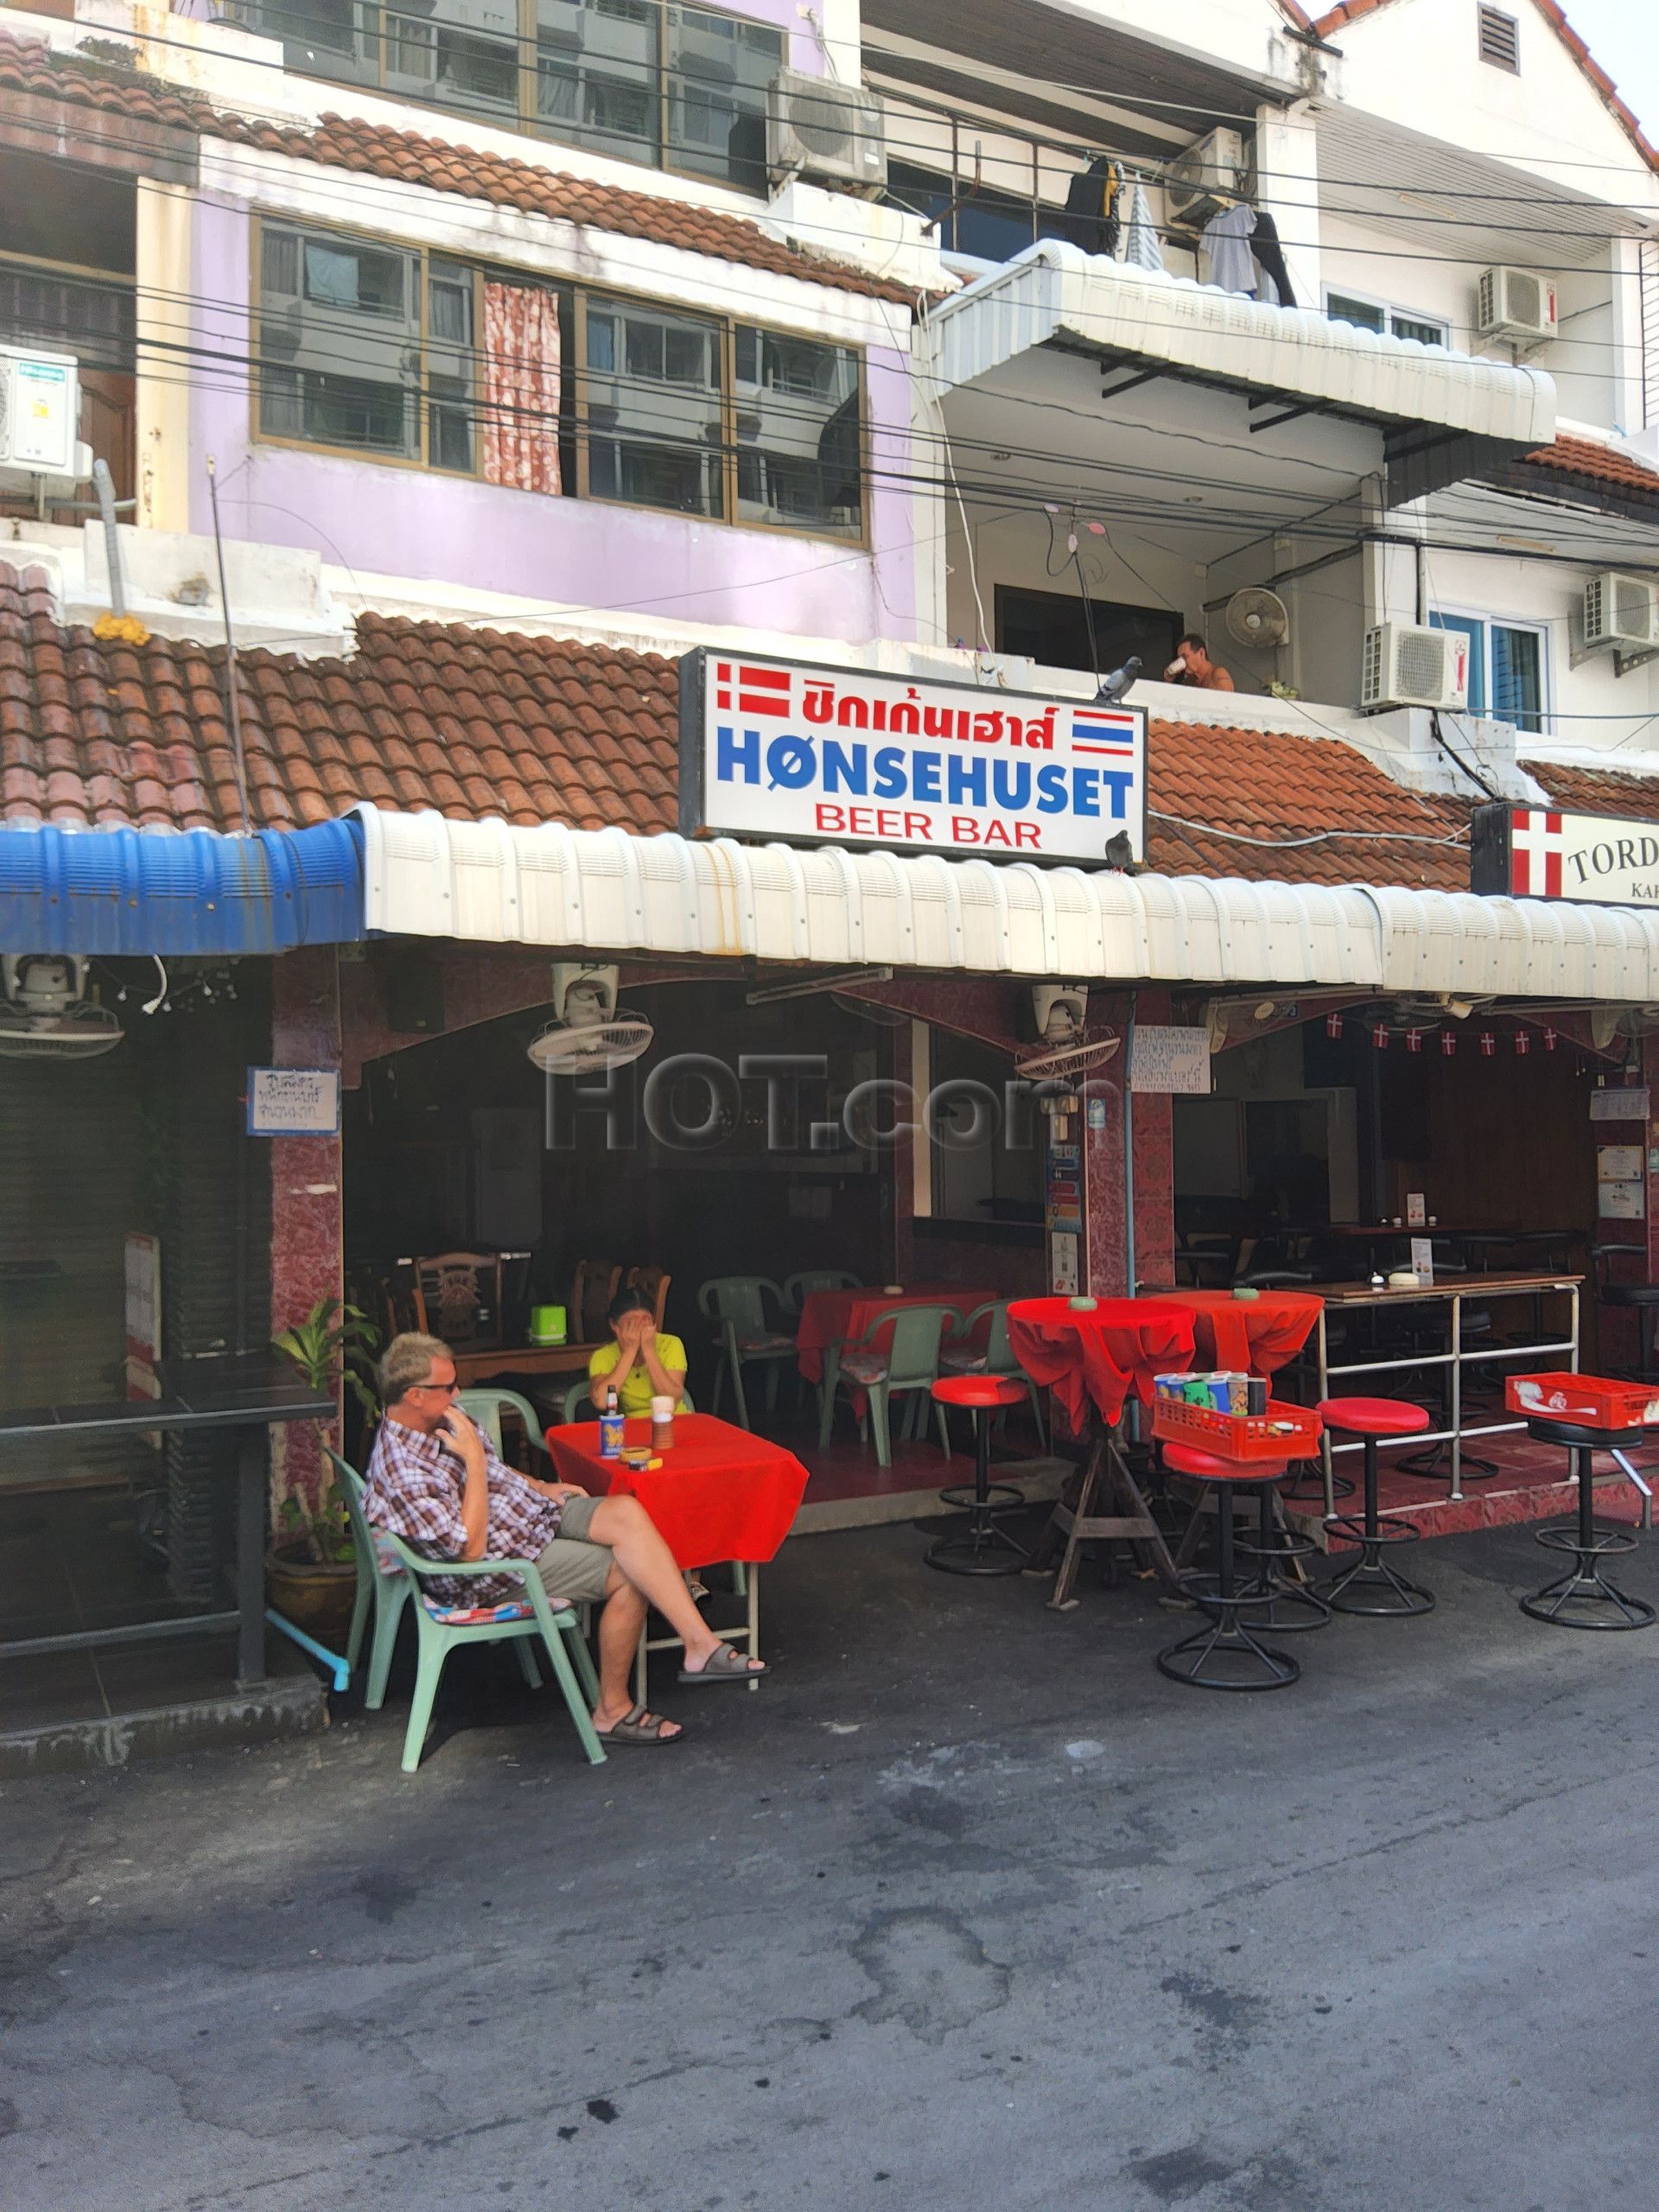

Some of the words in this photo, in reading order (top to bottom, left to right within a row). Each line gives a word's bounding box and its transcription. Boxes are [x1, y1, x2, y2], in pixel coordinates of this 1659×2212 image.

[716, 726, 1134, 819] HØNSEHUSET
[815, 804, 932, 840] BEER
[951, 816, 1042, 849] BAR
[1568, 837, 1659, 885] TORD
